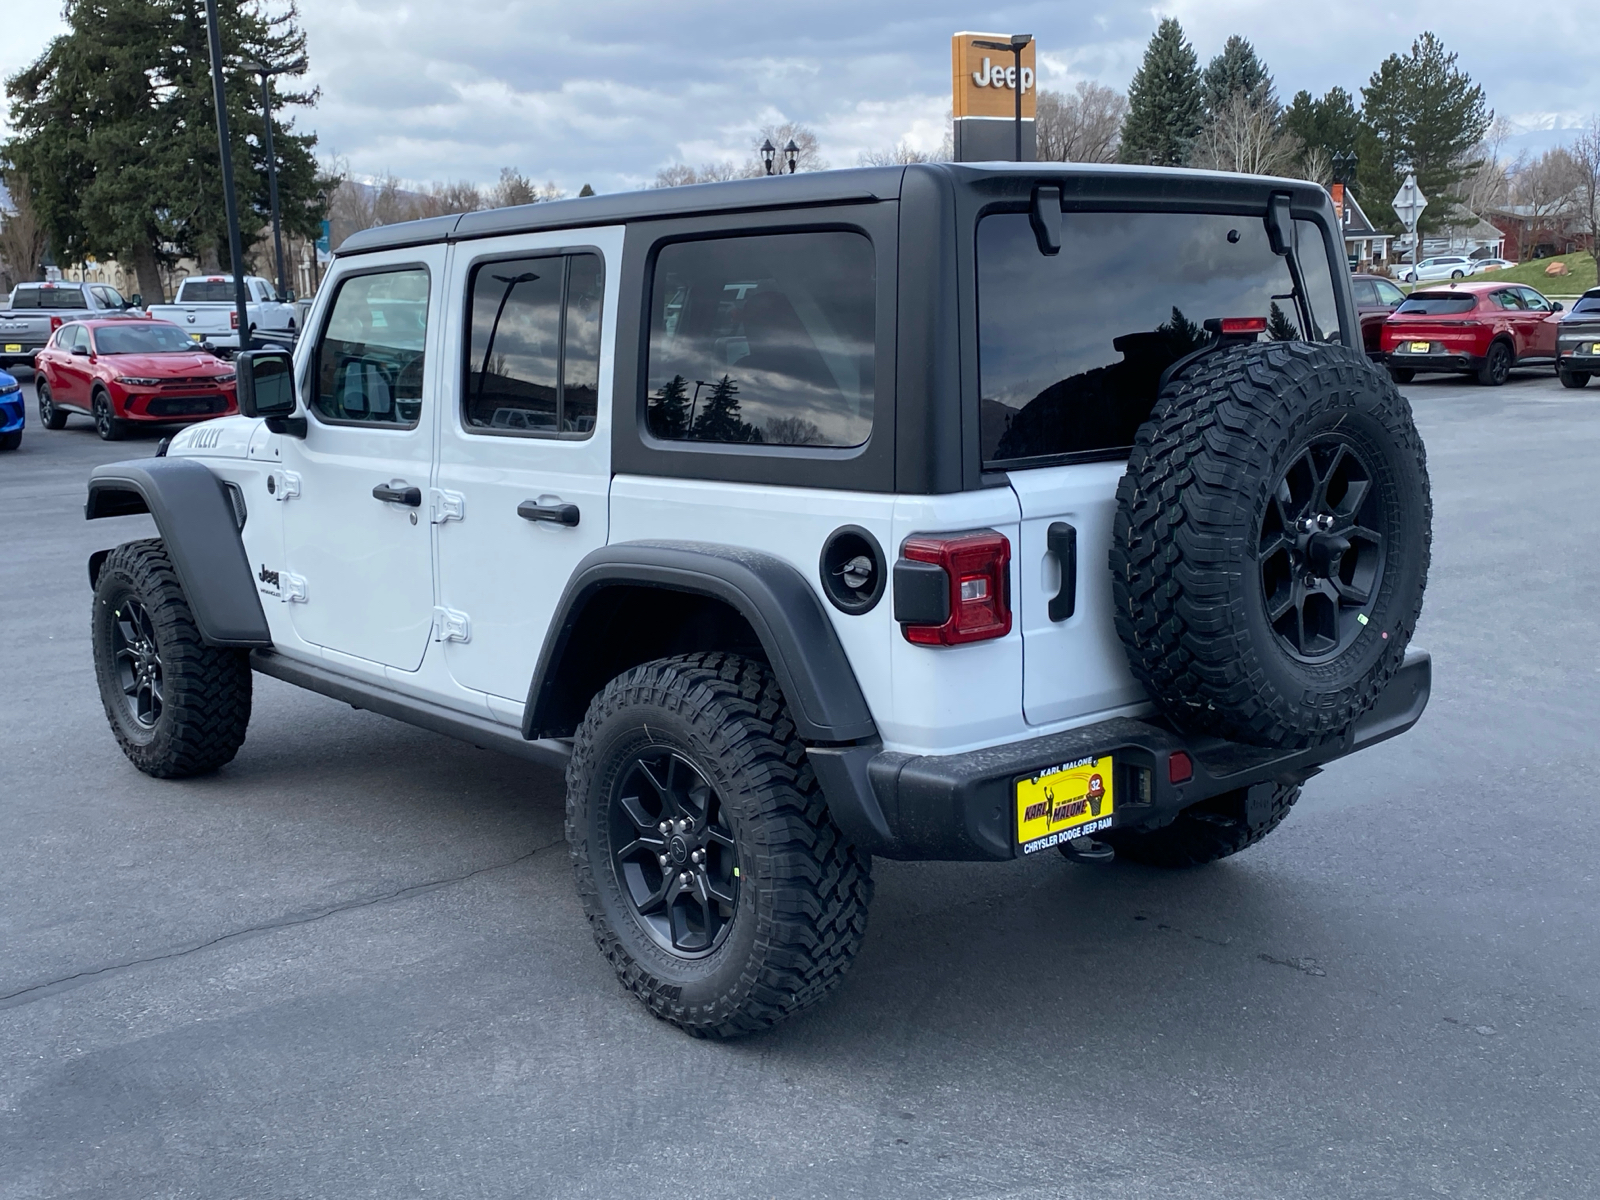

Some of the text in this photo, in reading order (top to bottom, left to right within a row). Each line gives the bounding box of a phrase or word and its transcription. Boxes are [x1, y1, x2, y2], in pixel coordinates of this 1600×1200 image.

[972, 57, 1034, 94] Jeep
[187, 428, 224, 449] WILLYS
[1040, 756, 1093, 778] KARL MALONE
[1091, 779, 1100, 791] 32
[1024, 800, 1048, 823] KARL
[1052, 798, 1088, 824] MALONE
[1024, 817, 1112, 855] CHRYSLER DODGE JEEP RAM
